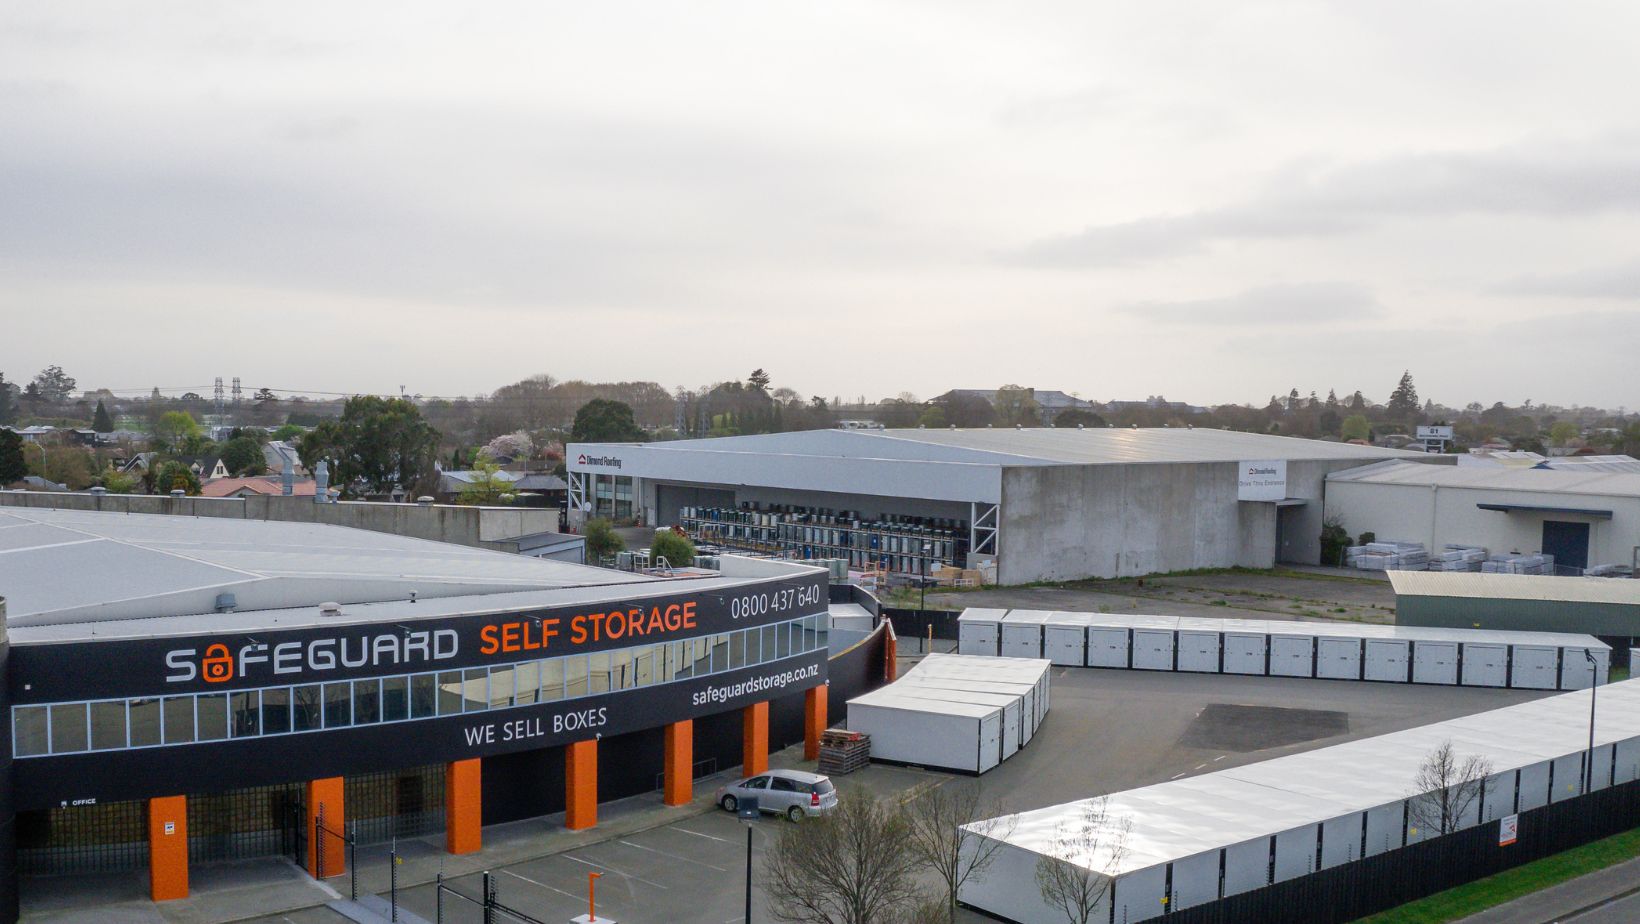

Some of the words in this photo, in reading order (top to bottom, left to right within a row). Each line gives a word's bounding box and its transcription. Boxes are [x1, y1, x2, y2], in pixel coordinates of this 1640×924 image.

[587, 456, 603, 466] Dimond
[604, 456, 622, 469] Roofing
[731, 594, 768, 620] 0800
[771, 589, 795, 613] 437
[797, 584, 820, 608] 640
[480, 618, 560, 655] SELF
[570, 601, 697, 645] STORAGE
[692, 664, 819, 706] safeguardstorage.co.nz
[464, 724, 496, 747] WE
[503, 716, 545, 741] SELL
[553, 707, 608, 734] BOXES
[72, 798, 96, 806] OFFICE
